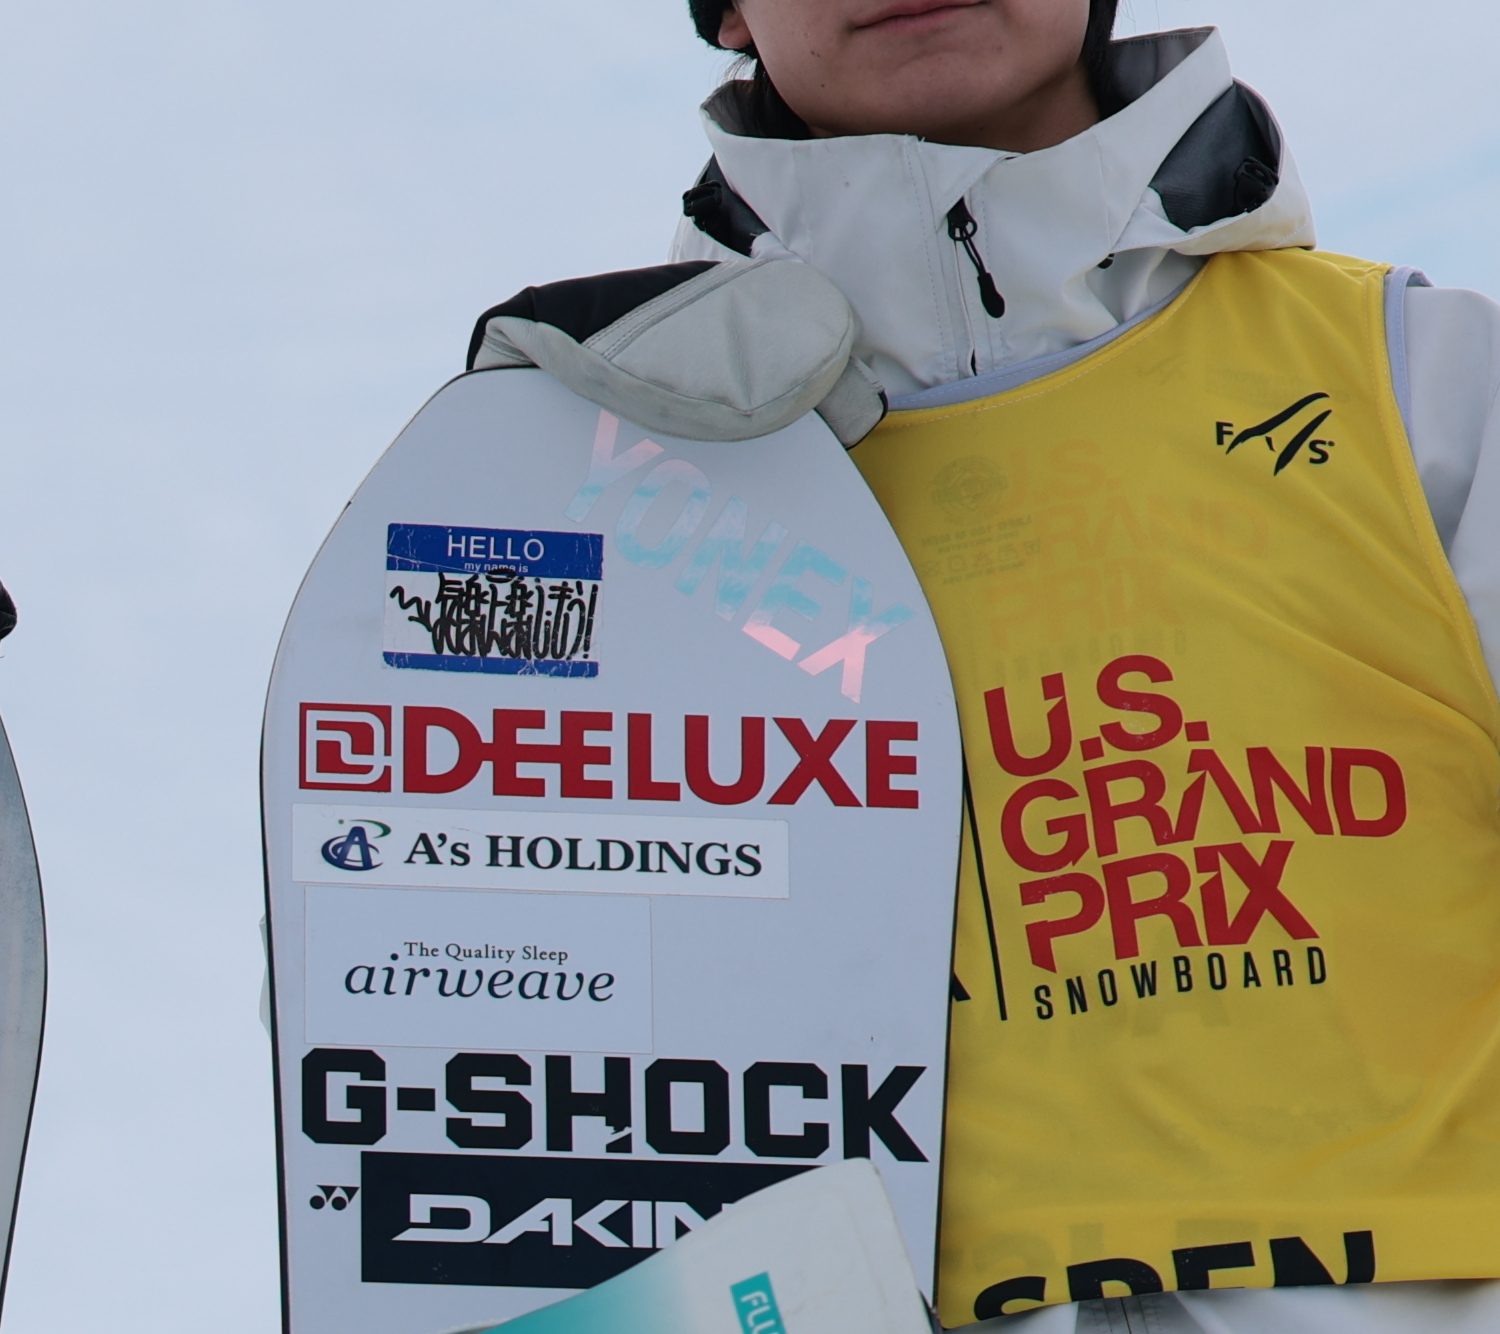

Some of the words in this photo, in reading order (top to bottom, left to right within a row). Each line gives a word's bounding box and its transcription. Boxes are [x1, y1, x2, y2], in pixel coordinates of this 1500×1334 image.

[447, 535, 545, 561] HELLO
[464, 562, 481, 574] my
[519, 563, 529, 573] is
[564, 408, 916, 703] YONEX
[402, 705, 920, 809] DEELUXE
[983, 654, 1209, 778] U.S.
[1000, 745, 1407, 873] GRAND
[404, 832, 471, 866] A's
[485, 834, 763, 878] HOLDINGS
[1019, 840, 1320, 973] PRIX
[344, 953, 616, 1002] airweave
[404, 941, 440, 958] The
[445, 942, 516, 964] Quality
[522, 945, 569, 963] Sleep
[1034, 946, 1328, 1021] SNOWBOARD
[301, 1046, 930, 1163] G-SHOCK
